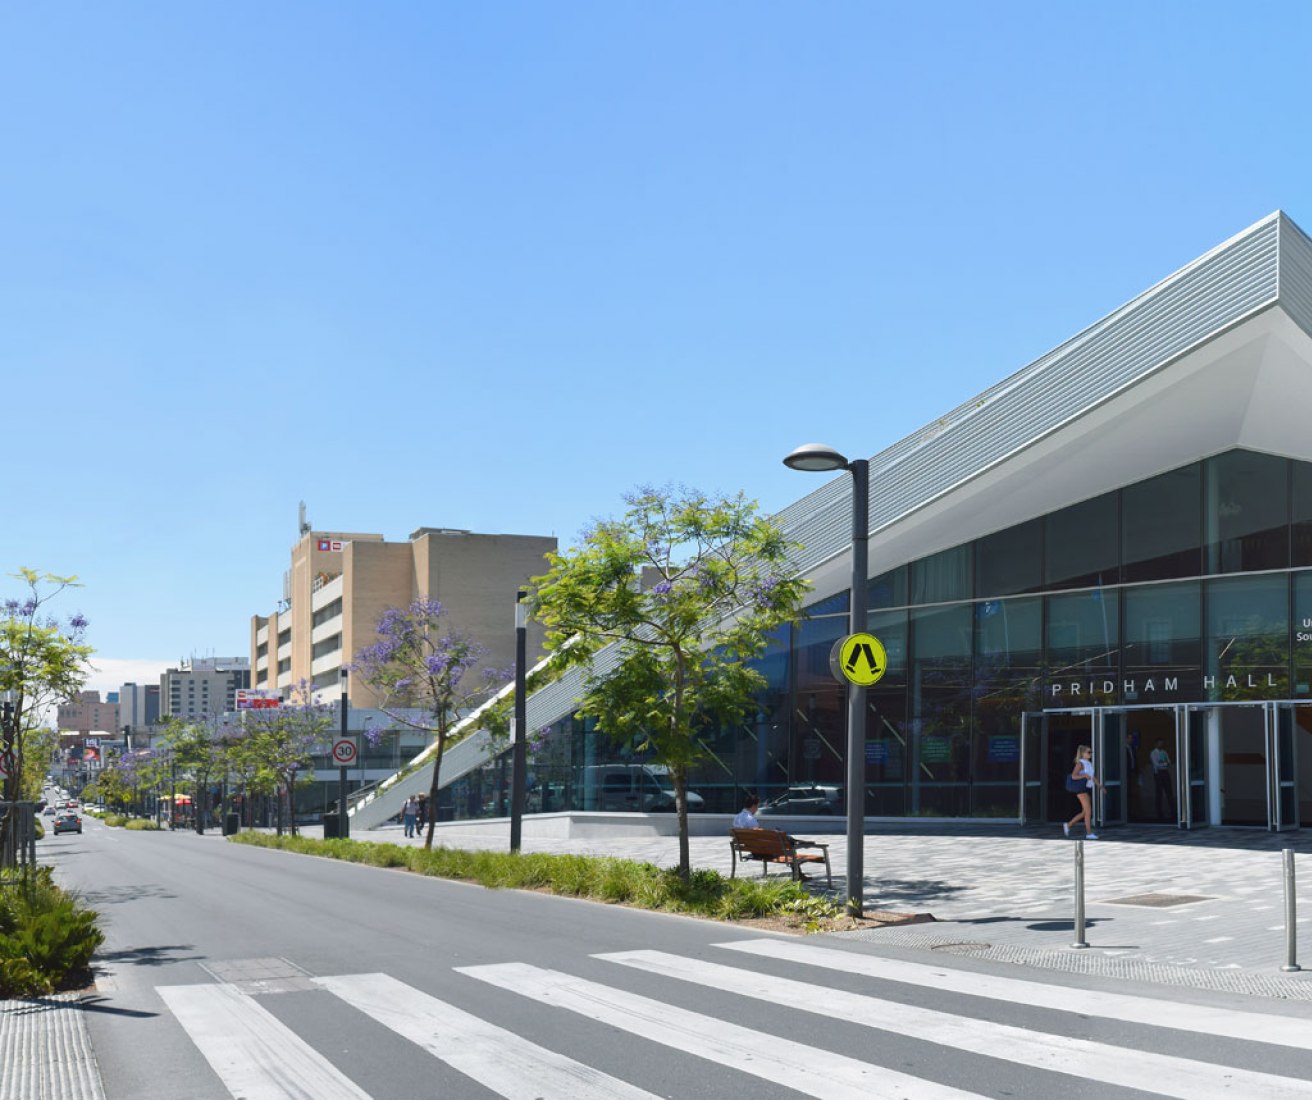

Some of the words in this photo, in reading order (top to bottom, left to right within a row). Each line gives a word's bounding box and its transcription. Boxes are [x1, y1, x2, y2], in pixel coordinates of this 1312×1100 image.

[1052, 677, 1179, 697] PRIDHAM
[1204, 673, 1277, 689] HALL
[338, 746, 352, 757] 30
